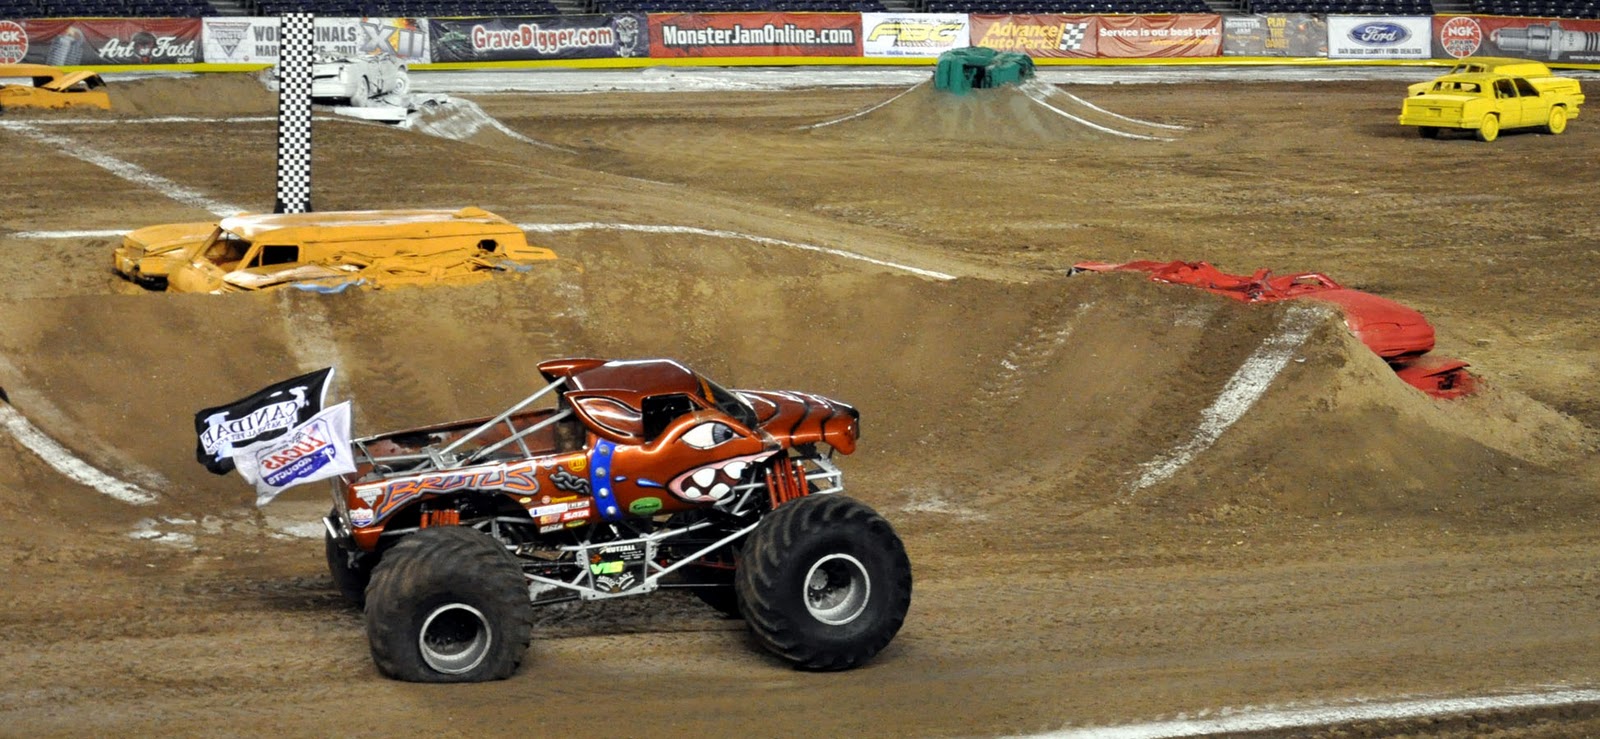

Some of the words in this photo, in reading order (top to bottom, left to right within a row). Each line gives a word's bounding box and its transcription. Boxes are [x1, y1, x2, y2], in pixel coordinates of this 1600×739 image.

[986, 22, 1058, 38] Advance
[1267, 17, 1287, 27] PLAY
[0, 31, 20, 42] GK
[253, 26, 281, 42] WOR
[313, 27, 357, 42] INALS
[472, 24, 614, 53] GraveDigger.com
[662, 24, 854, 46] MonsterJamOnline.com
[1099, 27, 1138, 37] Service
[1140, 28, 1150, 37] is
[1152, 29, 1169, 37] our
[1171, 28, 1194, 37] best
[1195, 28, 1220, 39] part.
[1270, 28, 1284, 37] THE
[1361, 25, 1397, 42] Ford
[1448, 26, 1475, 37] NGK
[100, 40, 135, 58] Art
[152, 37, 195, 57] Fast
[361, 22, 428, 58] XII
[978, 36, 1014, 49] Auto
[1014, 37, 1052, 49] Parts
[255, 45, 280, 56] MAR
[377, 464, 537, 520] BRUTUS
